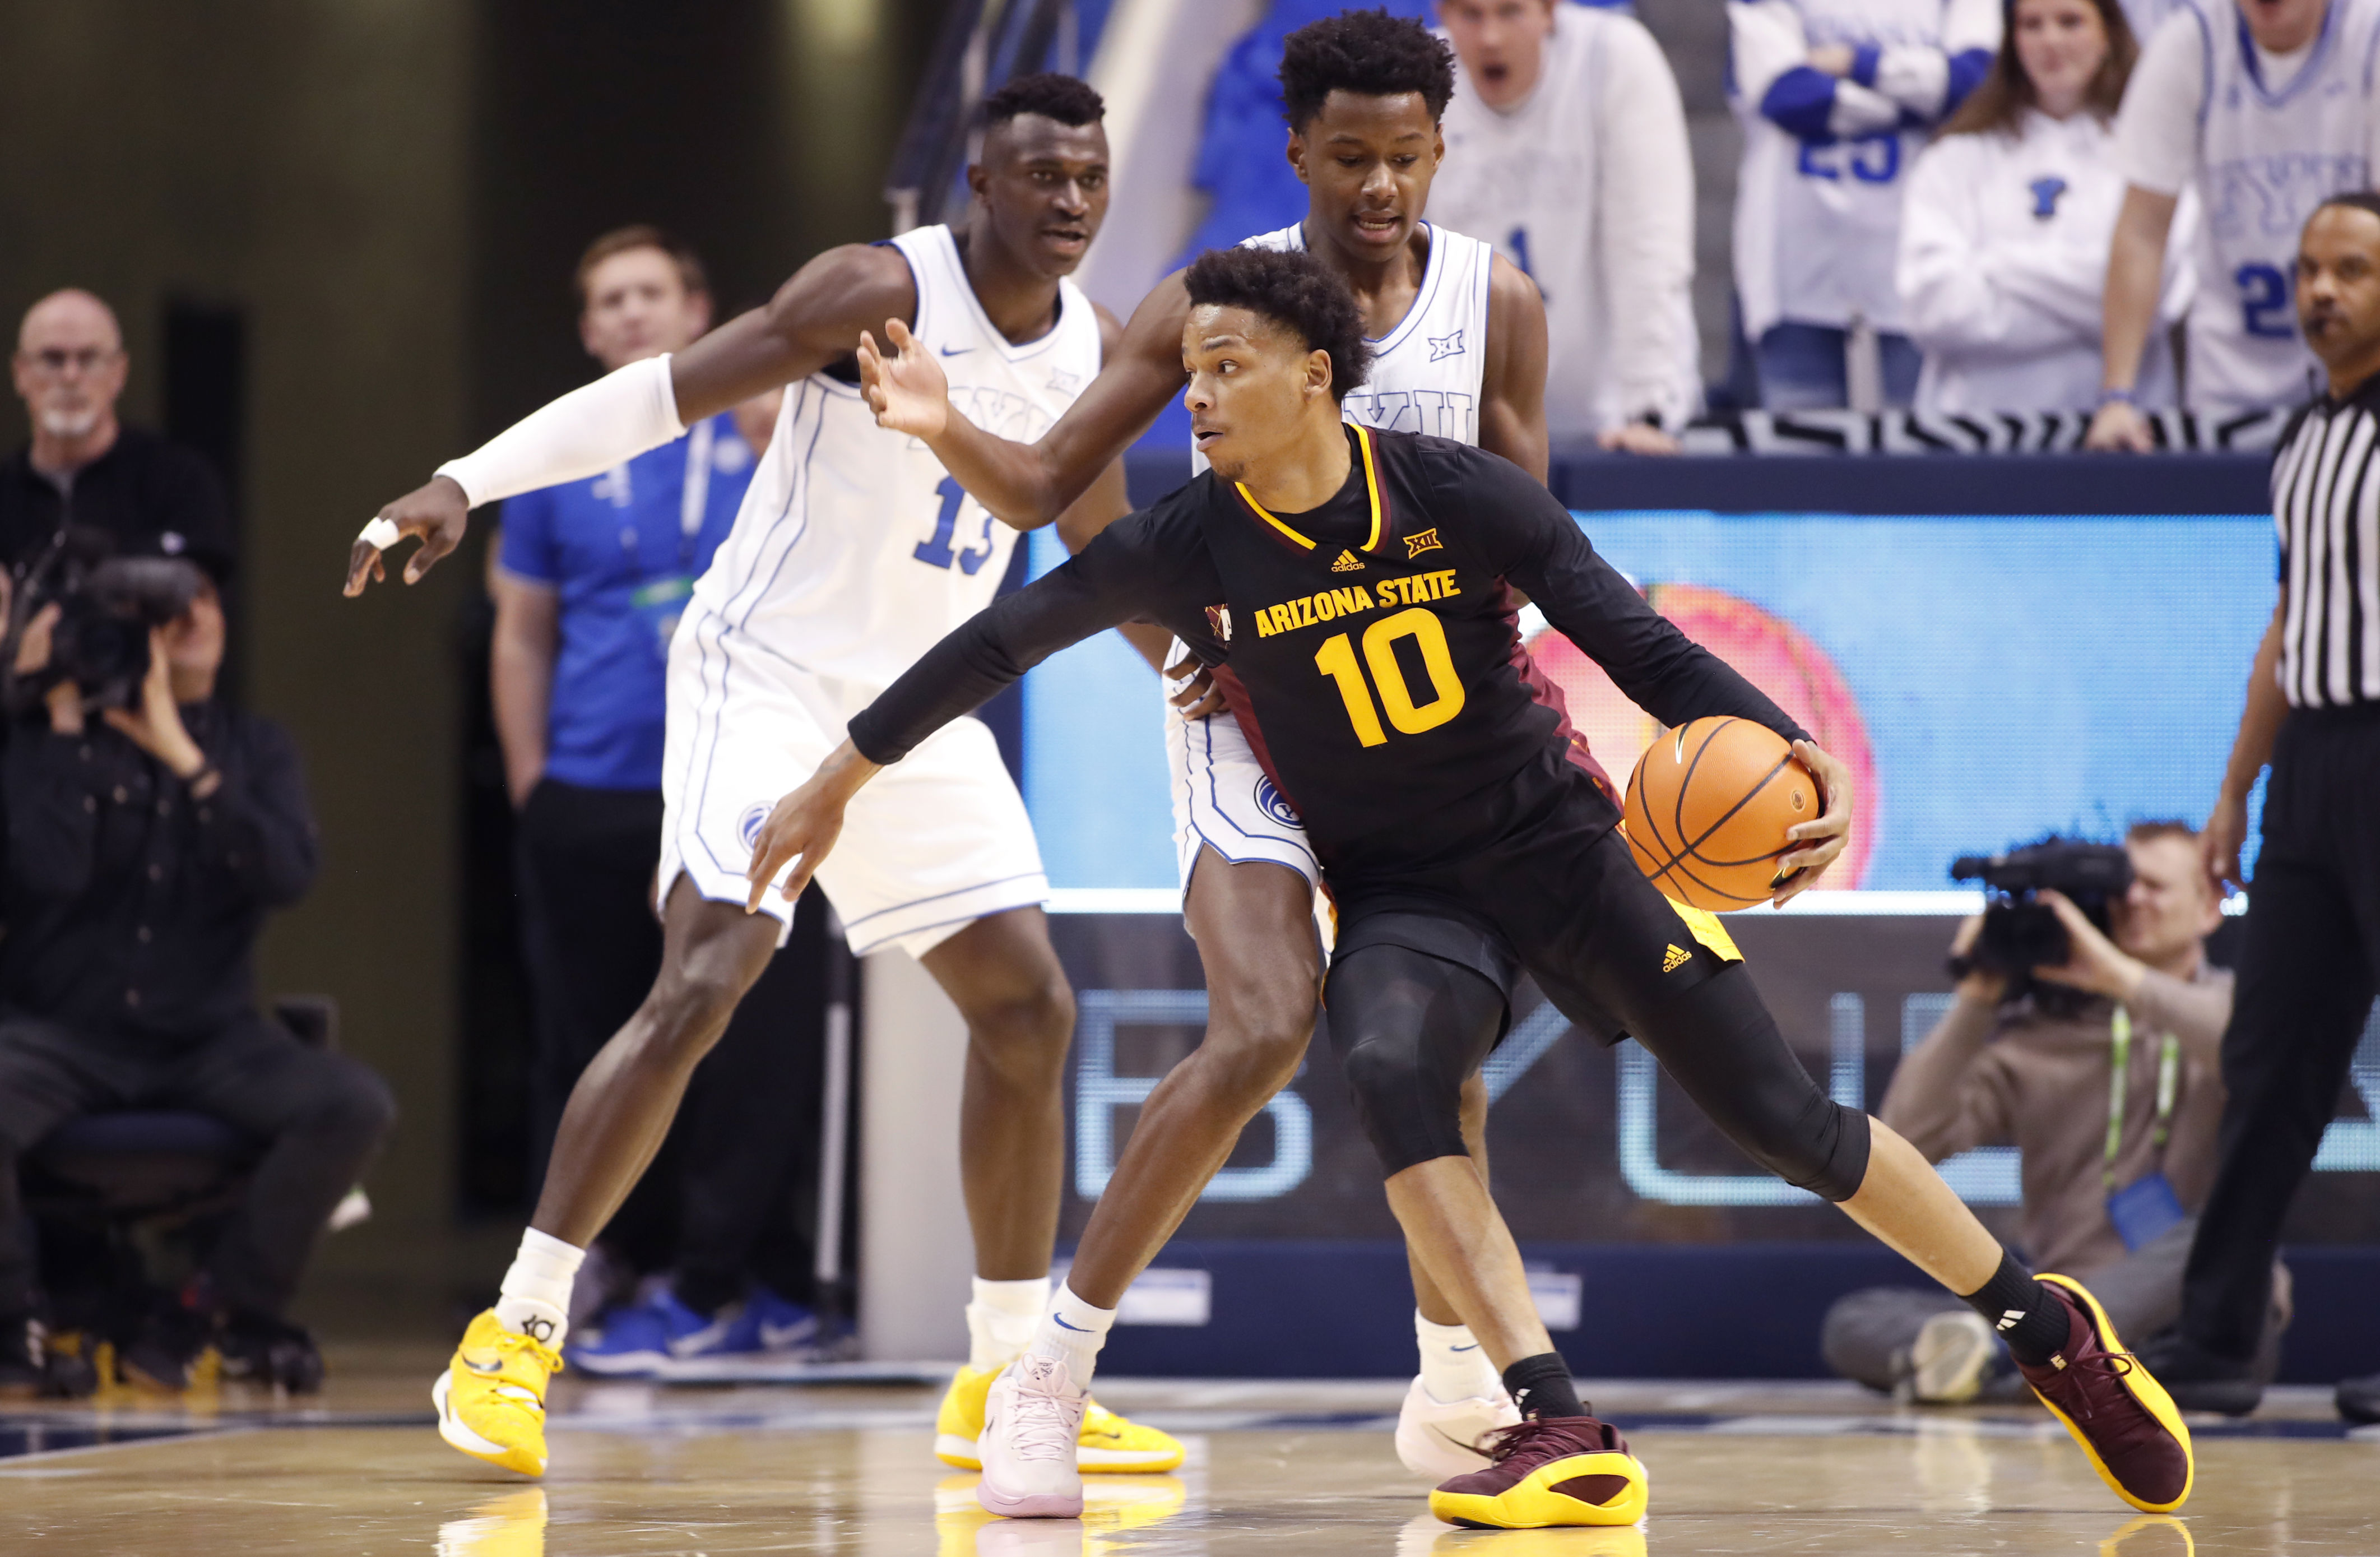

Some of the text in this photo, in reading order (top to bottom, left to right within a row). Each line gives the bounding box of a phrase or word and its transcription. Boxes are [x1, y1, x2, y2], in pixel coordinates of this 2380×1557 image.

[1331, 562, 1365, 572] adidas
[1254, 569, 1461, 638] ARIZONA STATE
[1314, 607, 1465, 748] 10
[1663, 951, 1692, 972] adidas
